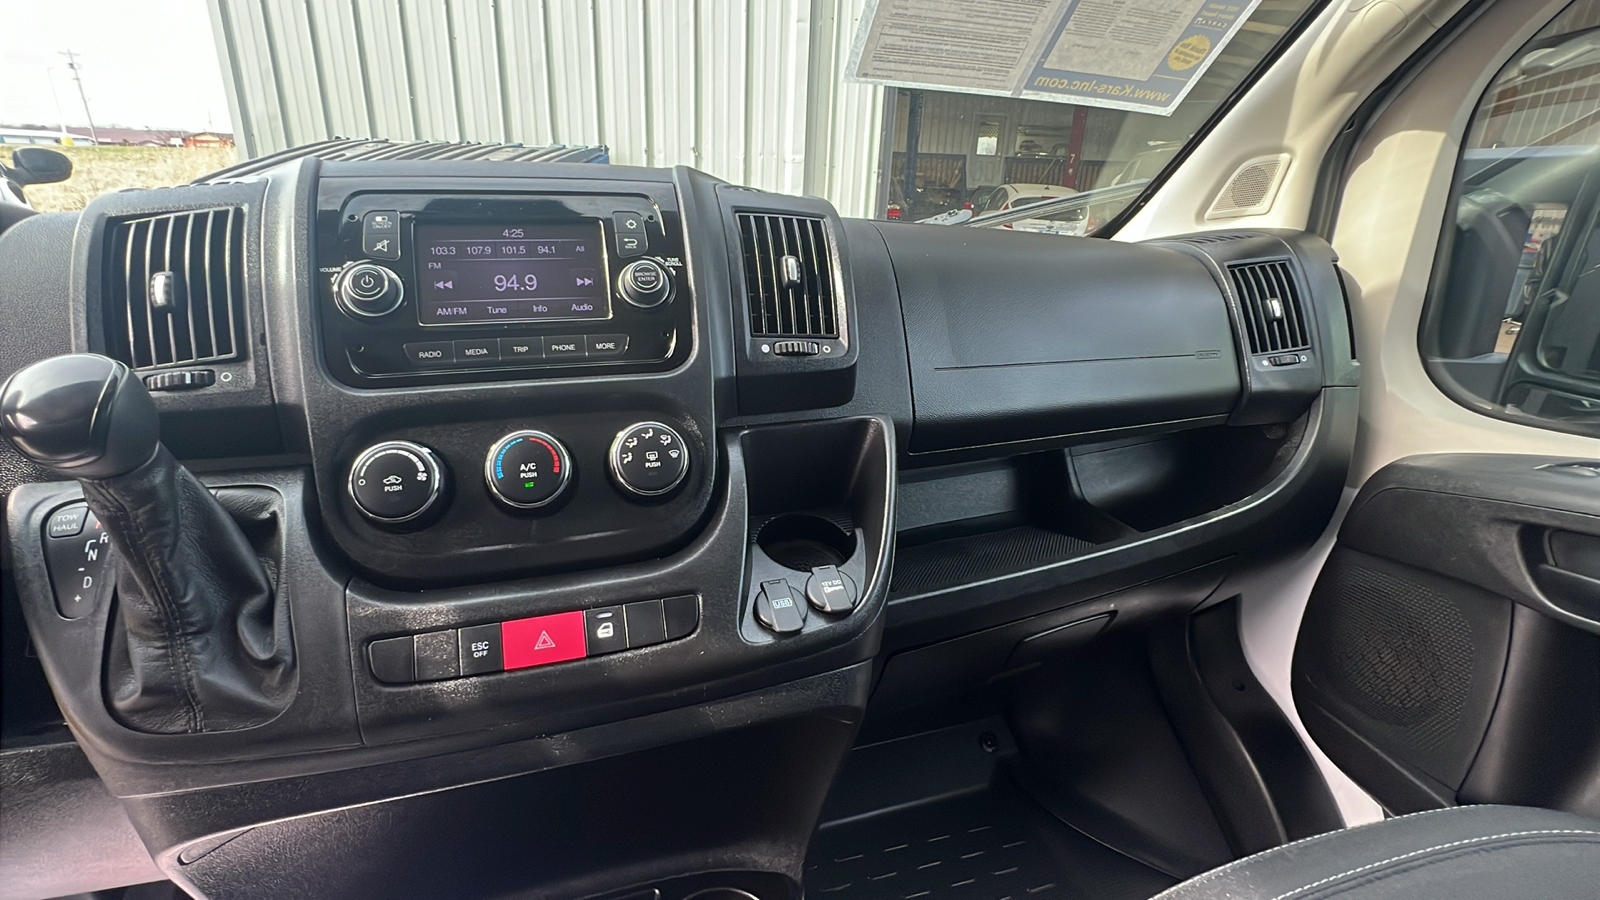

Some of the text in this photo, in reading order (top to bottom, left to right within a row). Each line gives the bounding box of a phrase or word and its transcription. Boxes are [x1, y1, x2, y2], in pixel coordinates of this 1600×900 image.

[502, 229, 524, 238] 4:25
[430, 246, 456, 255] 103.3
[466, 246, 492, 255] 107.9
[501, 246, 526, 254] 101.5
[537, 246, 556, 254] 94.1
[428, 262, 442, 270] FM
[493, 274, 538, 291] 94.9
[436, 303, 593, 316] AM/FM Tune Info Audio
[419, 350, 442, 358] RADIO
[465, 348, 488, 356] MEDIA
[595, 342, 615, 350] MORE
[520, 462, 536, 472] A/C
[645, 460, 661, 468] PUSH
[520, 471, 538, 479] PUSH
[384, 484, 403, 492] PUSH
[57, 514, 79, 522] TOW
[53, 522, 79, 532] HAUL
[99, 532, 109, 544] R
[88, 549, 98, 561] N
[83, 576, 92, 589] D
[774, 599, 791, 608] USB
[471, 641, 489, 651] ESC
[473, 650, 488, 658] OFF
